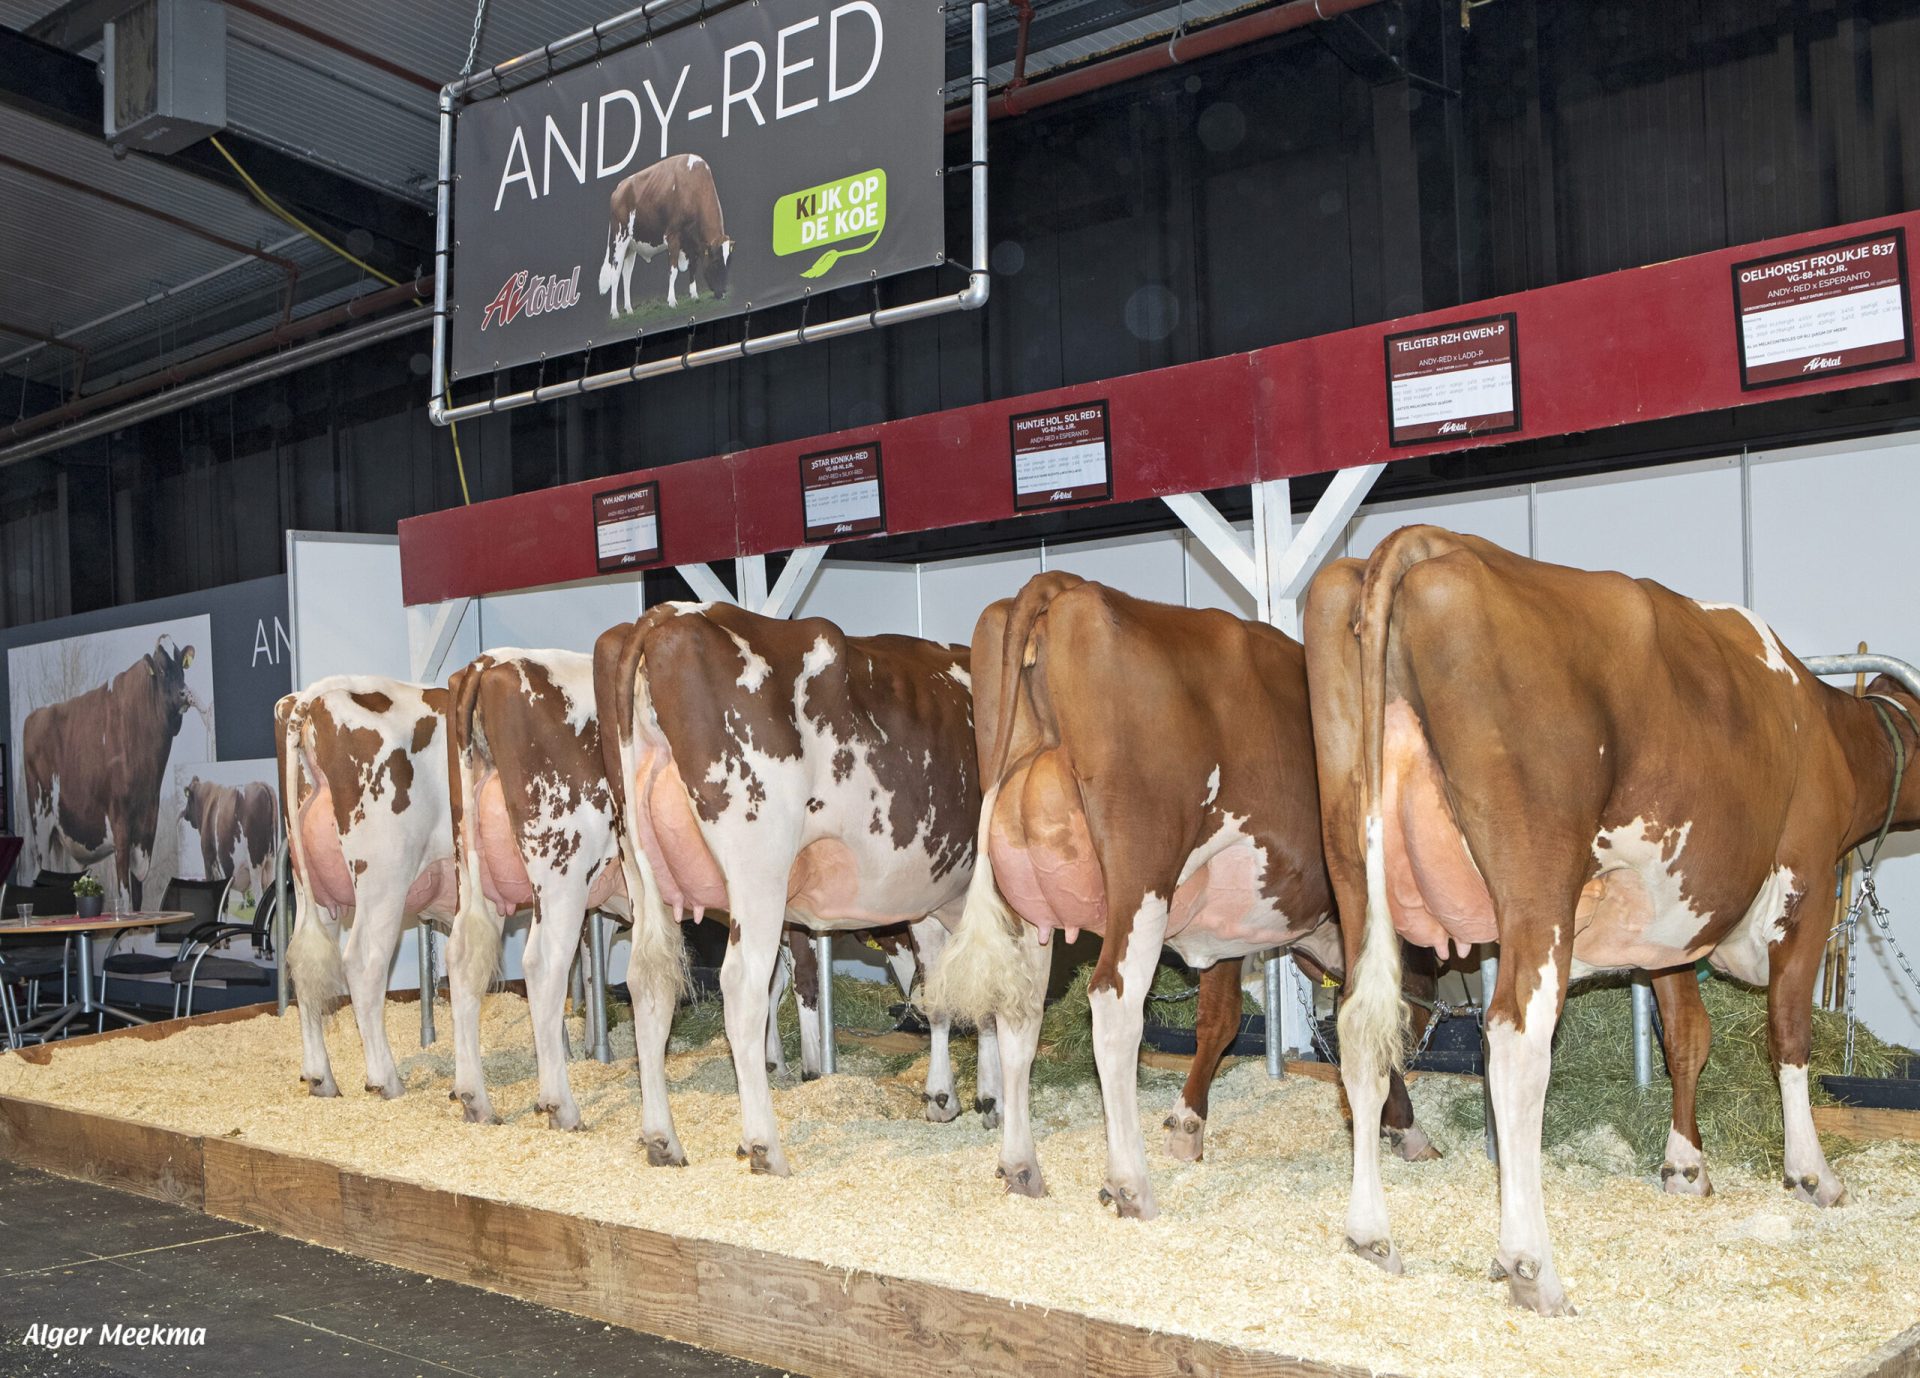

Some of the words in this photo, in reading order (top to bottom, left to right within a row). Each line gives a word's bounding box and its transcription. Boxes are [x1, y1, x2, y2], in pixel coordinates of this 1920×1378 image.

[494, 0, 884, 212] ANDY-RED
[796, 186, 842, 220] KIJK
[848, 176, 879, 205] OP
[801, 216, 829, 245] DE
[835, 202, 879, 236] KOE
[1741, 260, 1808, 283] OELHORST
[1810, 246, 1869, 269] FROUKJE
[1872, 242, 1896, 256] 837
[1787, 269, 1828, 283] VG-88-NL
[1830, 264, 1848, 275] 2JR.
[1767, 283, 1811, 299] ANDY-RED
[1819, 271, 1871, 288] ESPERANTO
[1397, 338, 1439, 352] TELGTER
[1441, 332, 1461, 345] RZH
[1462, 325, 1505, 341] GWEN-P
[1418, 354, 1452, 367] ANDY-RED
[1458, 350, 1484, 361] LADD-P
[1017, 418, 1045, 431] HUNTJE
[1064, 413, 1080, 423] SOL
[1080, 410, 1096, 420] RED
